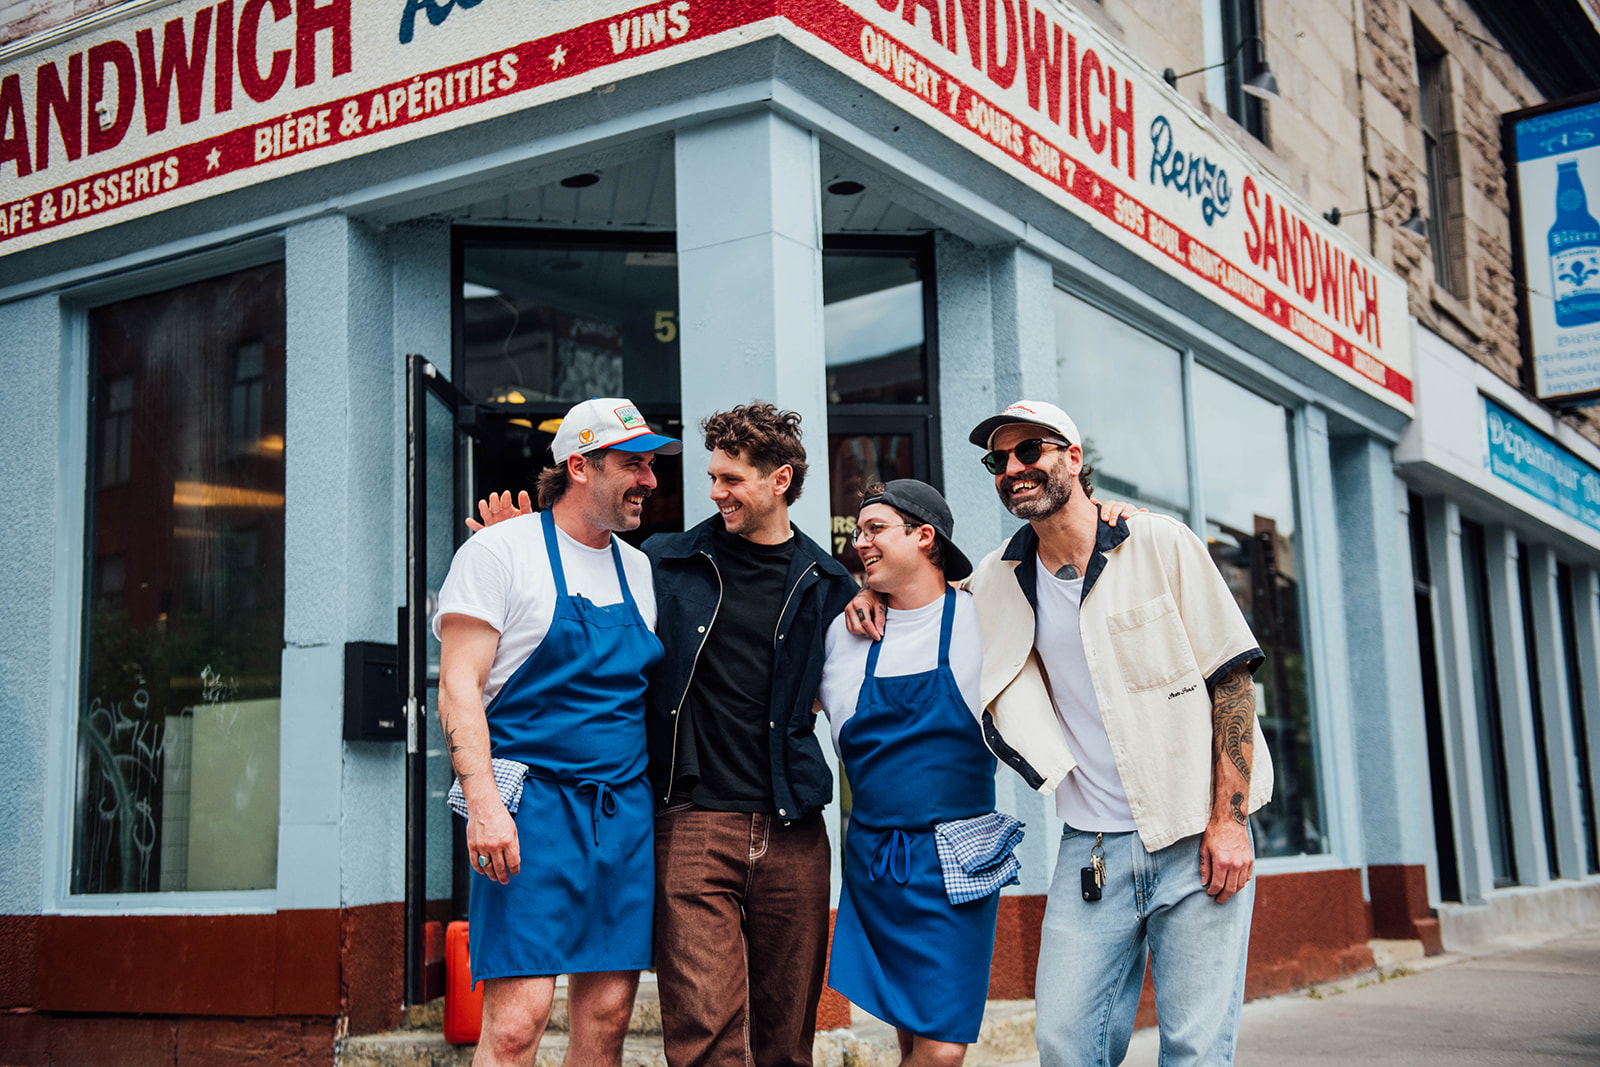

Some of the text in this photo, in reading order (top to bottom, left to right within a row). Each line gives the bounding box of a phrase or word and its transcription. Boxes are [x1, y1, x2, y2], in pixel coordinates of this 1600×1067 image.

[39, 192, 57, 224] &
[61, 156, 179, 219] DESSERTS
[339, 100, 363, 136] &
[608, 1, 690, 54] VINS
[860, 25, 941, 103] OUVERT
[946, 80, 961, 115] 7
[965, 95, 1024, 157] JOURS
[1028, 134, 1061, 181] SUR
[1063, 158, 1077, 187] 7
[1113, 191, 1145, 235] 5195
[874, 0, 1382, 350] NDWICH Renzo SANDWICH
[654, 310, 679, 343] 5
[831, 515, 857, 534] RS
[834, 536, 847, 555] 7
